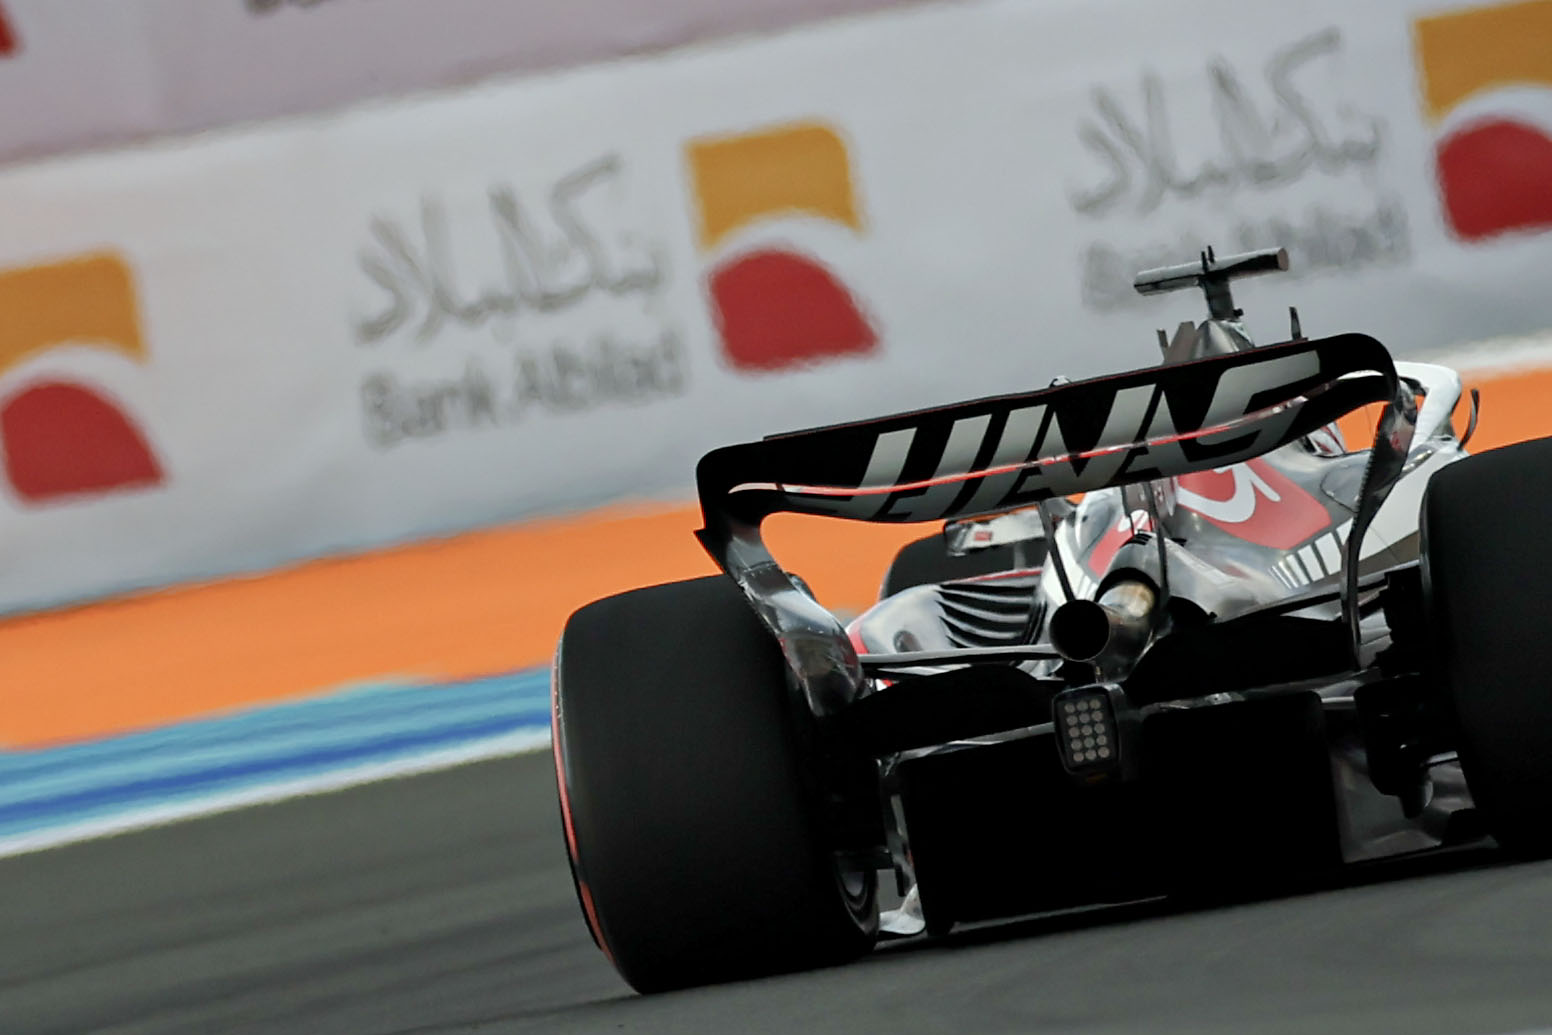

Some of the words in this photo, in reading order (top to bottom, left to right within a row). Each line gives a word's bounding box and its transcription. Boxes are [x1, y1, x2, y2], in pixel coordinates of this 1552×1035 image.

[361, 355, 500, 452] Bank
[508, 328, 690, 419] Albilad
[800, 350, 1321, 522] HAAS
